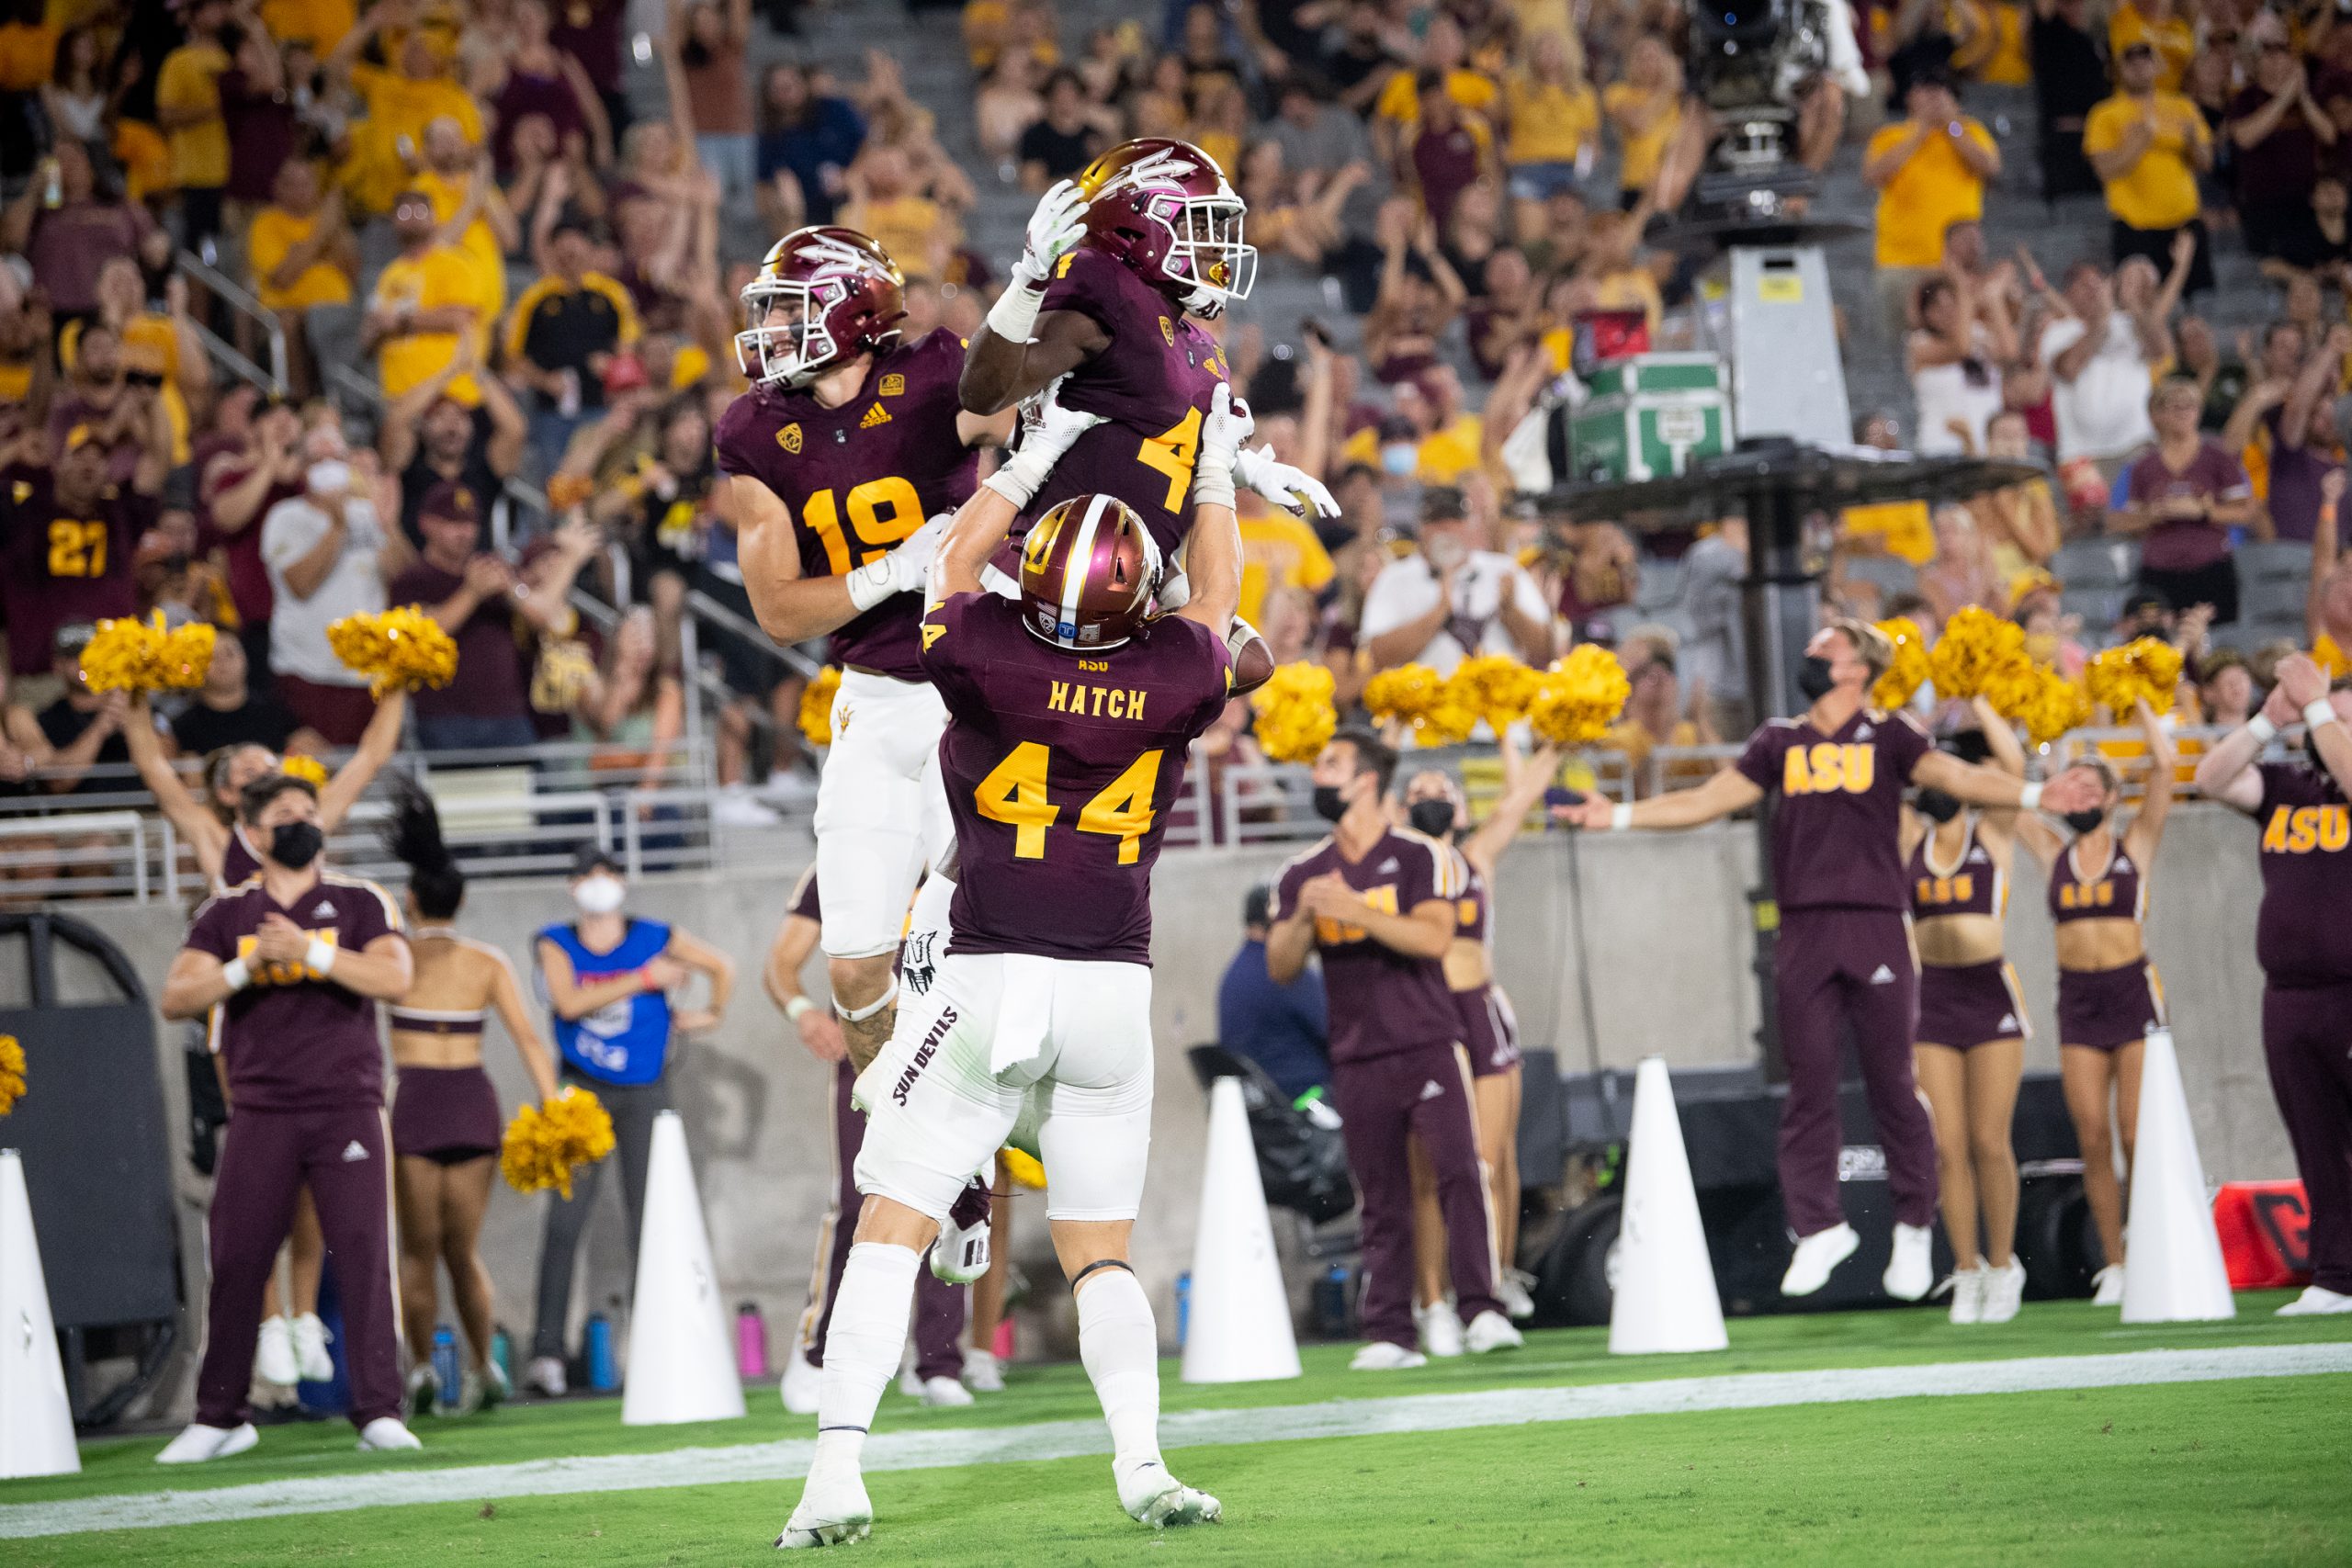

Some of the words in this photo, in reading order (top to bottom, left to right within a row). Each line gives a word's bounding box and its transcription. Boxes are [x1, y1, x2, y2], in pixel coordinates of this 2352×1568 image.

[1136, 405, 1203, 514] 4
[802, 476, 926, 576] 19
[1047, 680, 1148, 721] HATCH
[1079, 660, 1109, 672] ASU
[974, 740, 1165, 865] 44
[1782, 741, 1875, 797] ASU
[2263, 804, 2351, 854] ASU
[893, 1065, 921, 1108] SUN
[913, 1005, 958, 1070] DEVILS
